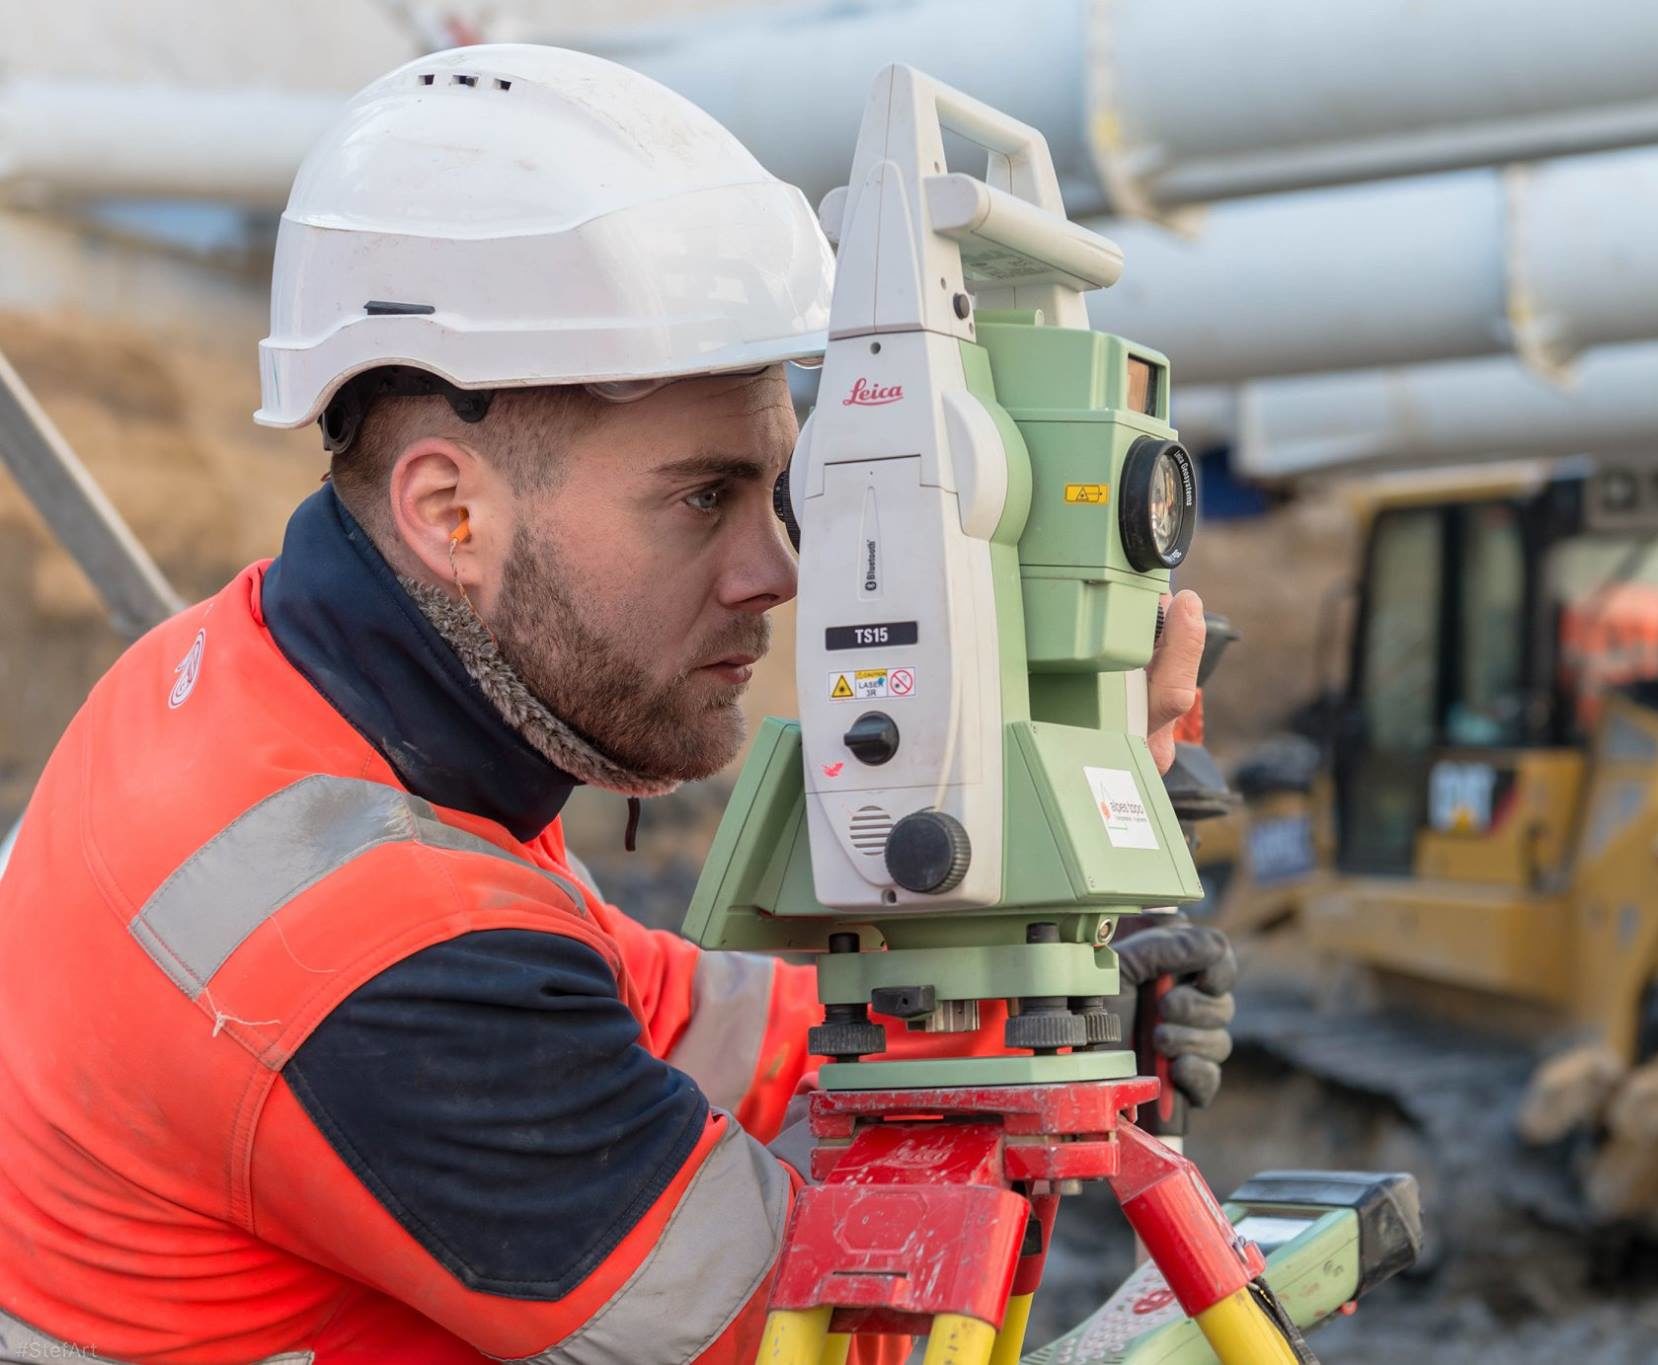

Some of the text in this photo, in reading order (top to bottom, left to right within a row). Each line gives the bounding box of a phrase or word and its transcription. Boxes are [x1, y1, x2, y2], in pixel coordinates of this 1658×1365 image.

[843, 378, 904, 406] Leica
[1181, 463, 1193, 506] Geosystems
[866, 541, 876, 580] Bluetooth
[854, 627, 889, 644] TS15
